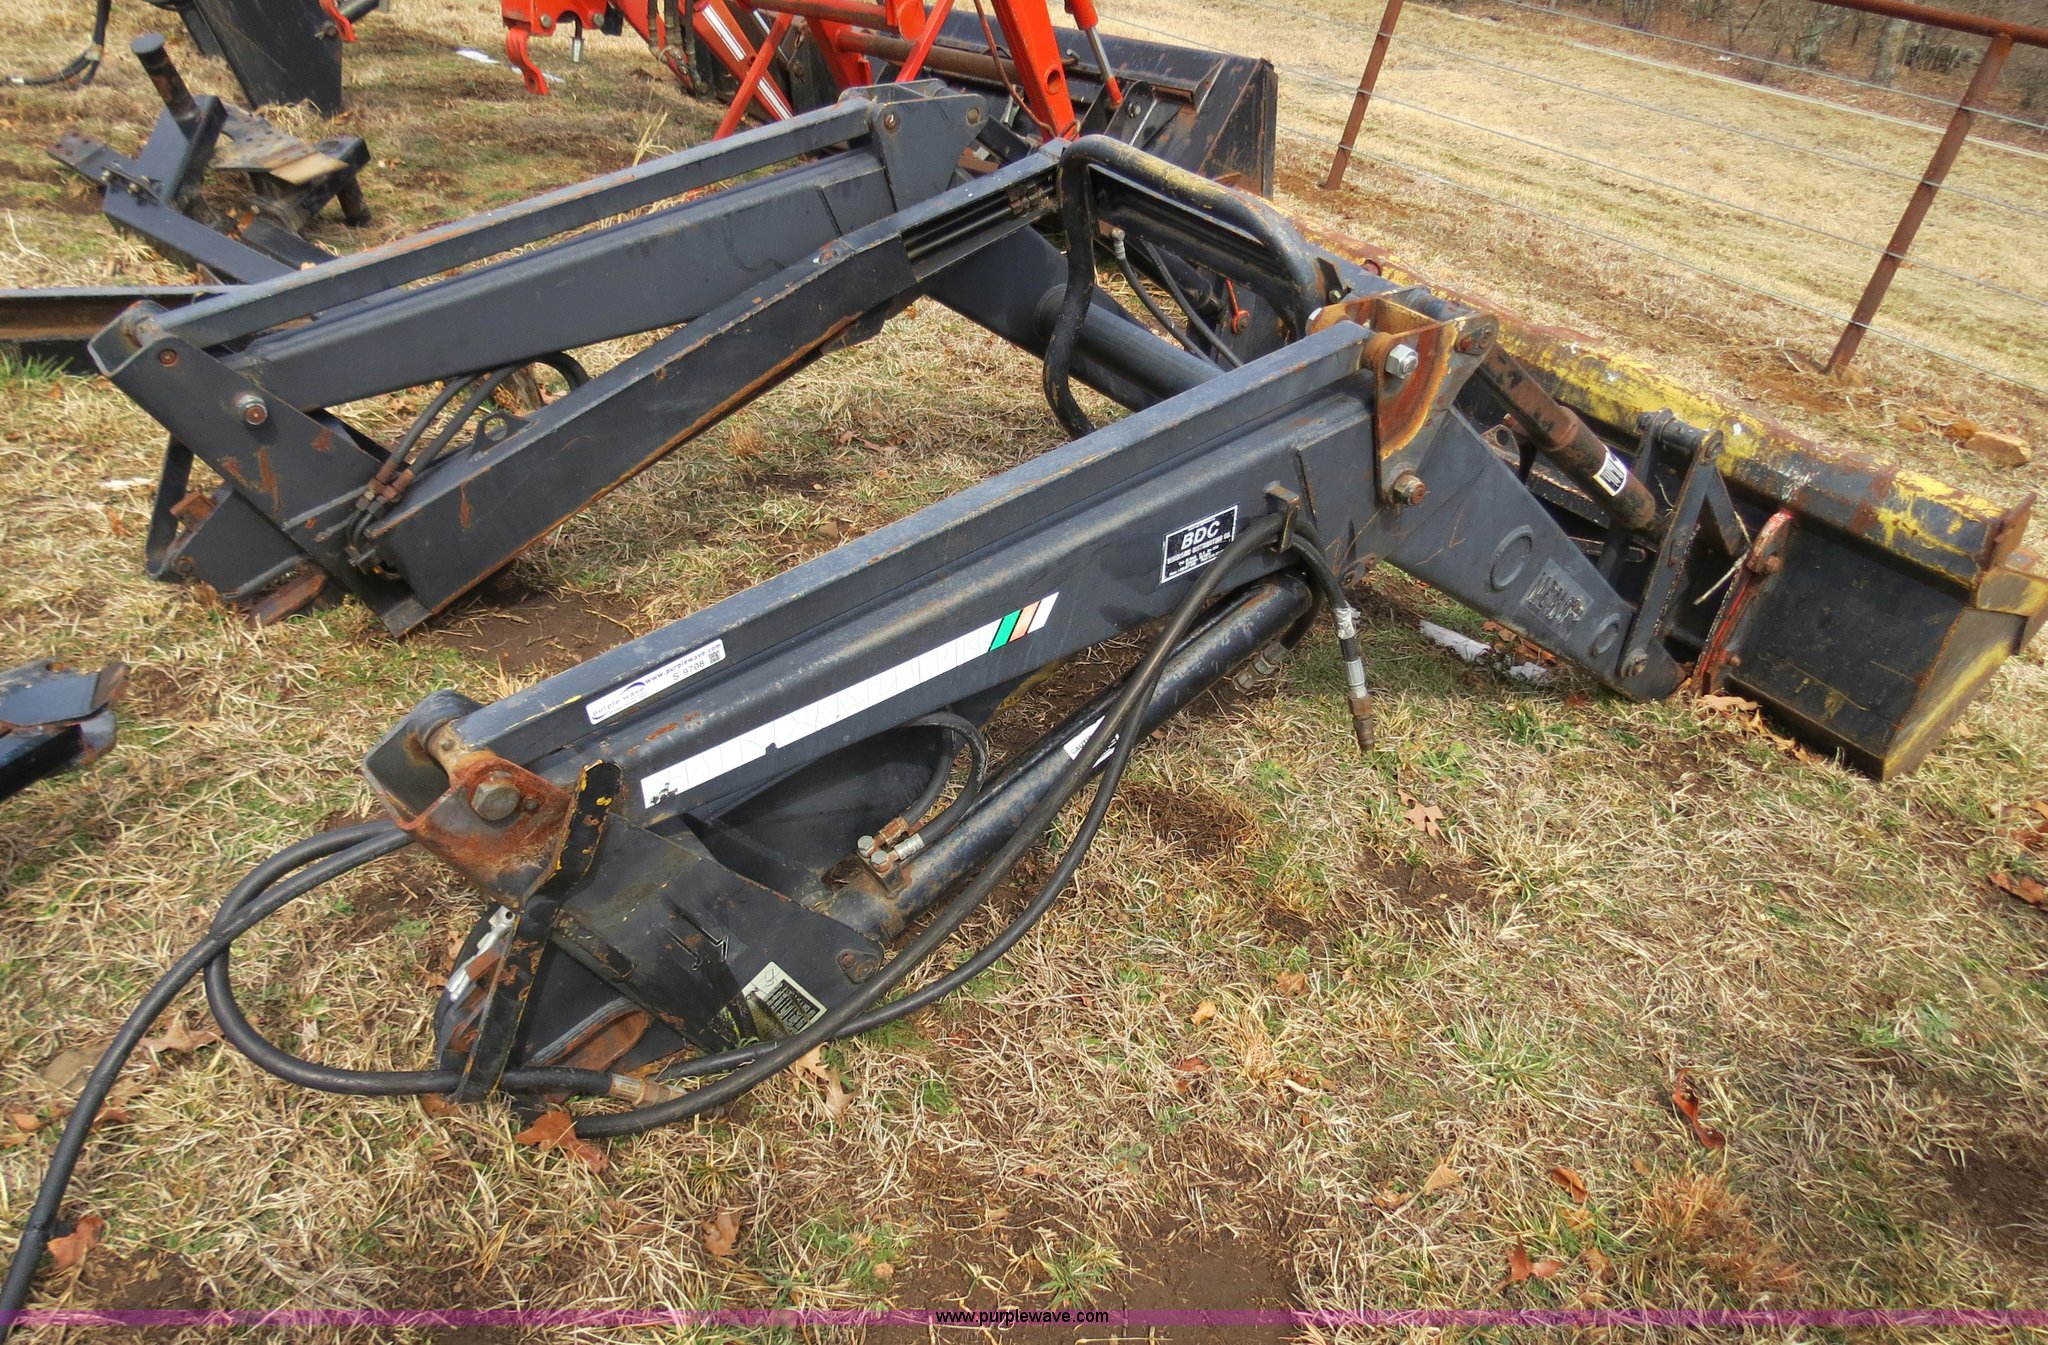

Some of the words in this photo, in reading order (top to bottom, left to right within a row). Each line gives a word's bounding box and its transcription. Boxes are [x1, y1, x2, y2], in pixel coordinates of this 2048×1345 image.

[1181, 520, 1220, 550] BDC
[645, 643, 722, 684] www.purplewave.com
[683, 660, 706, 677] 9708
[592, 697, 620, 717] purple
[622, 686, 646, 700] wave
